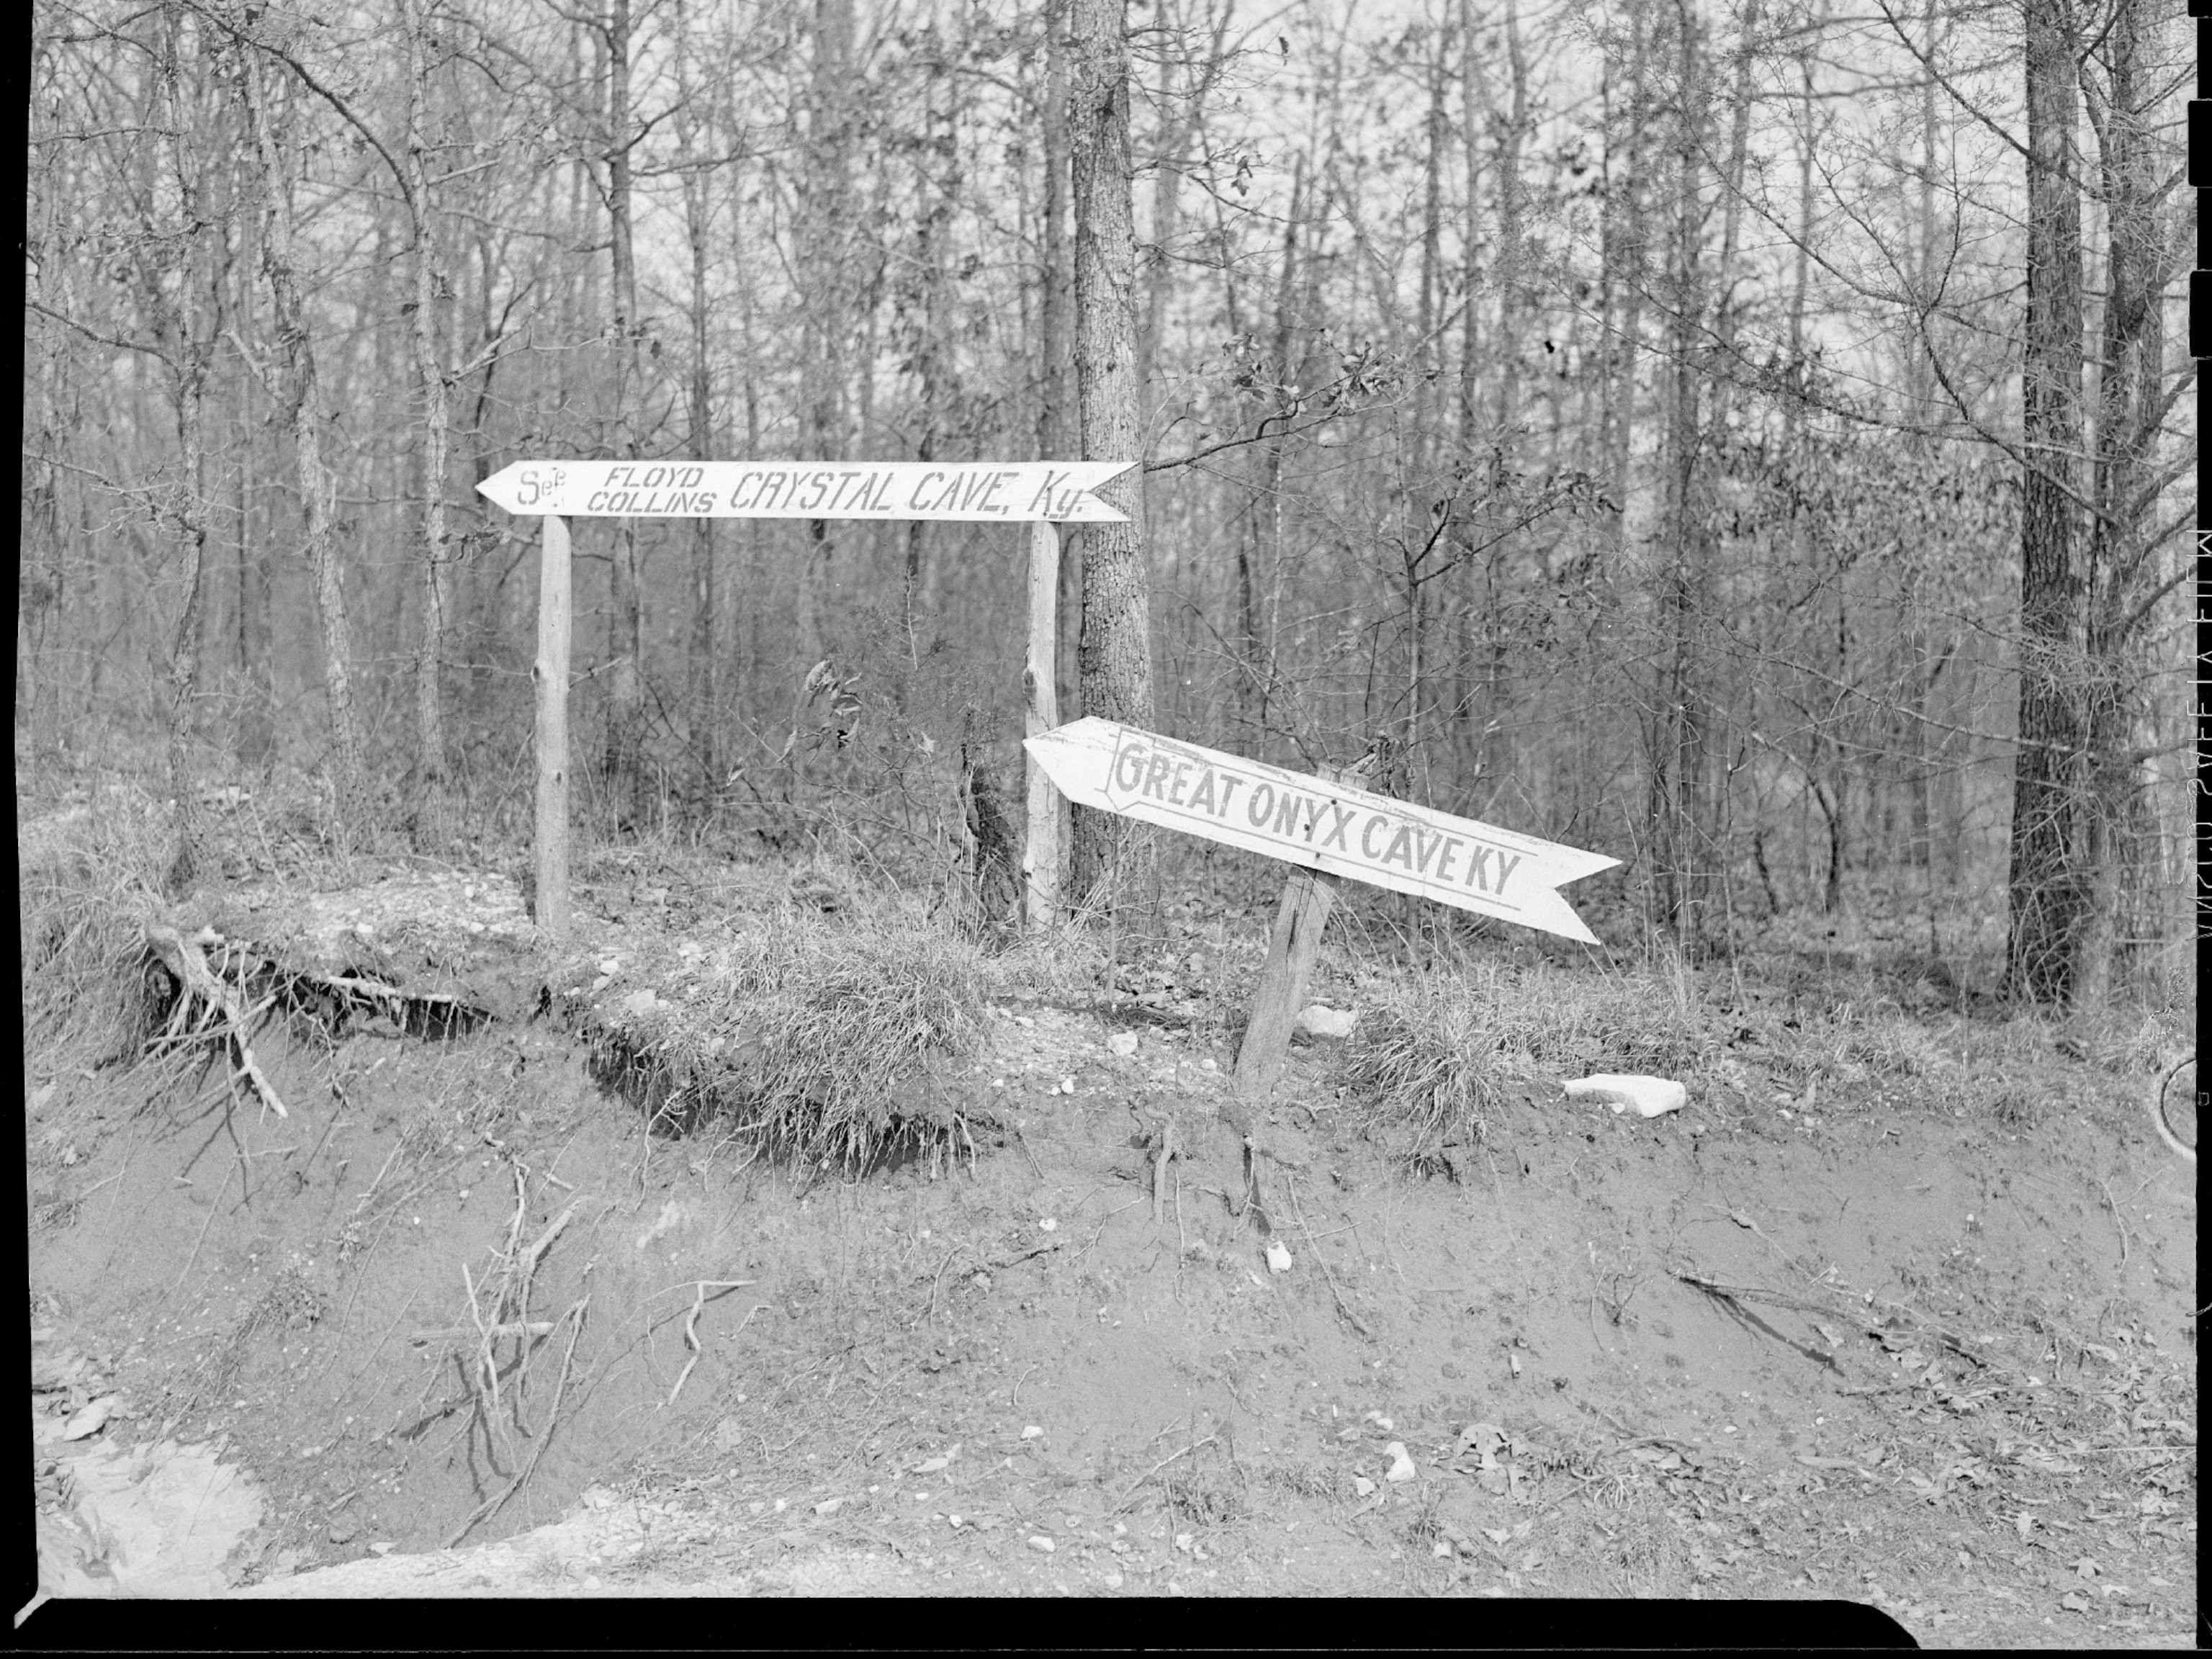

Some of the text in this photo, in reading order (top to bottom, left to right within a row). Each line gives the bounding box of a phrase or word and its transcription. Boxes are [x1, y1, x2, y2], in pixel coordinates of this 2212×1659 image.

[518, 470, 566, 505] See
[604, 467, 704, 488] FLOYD
[729, 470, 1083, 519] CRYSTAL CAVE, Ky.
[587, 492, 717, 513] COLLINS
[1116, 743, 1521, 896] GREAT ONYX CAVE KY
